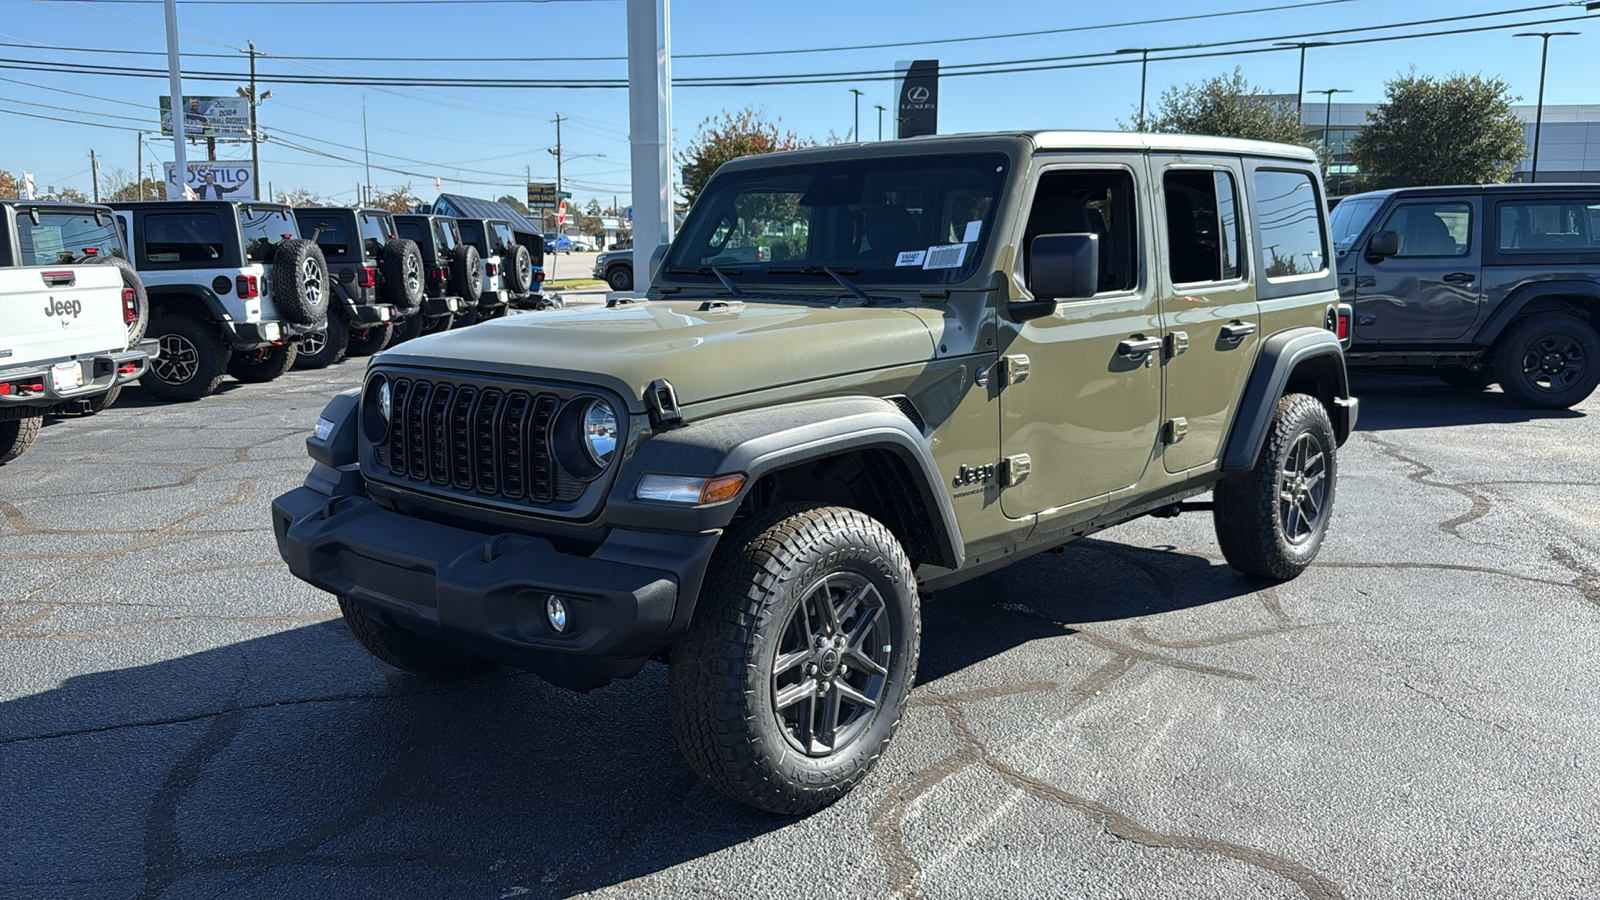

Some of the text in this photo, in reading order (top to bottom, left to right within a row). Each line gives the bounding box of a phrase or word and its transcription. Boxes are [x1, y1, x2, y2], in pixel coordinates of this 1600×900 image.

[218, 109, 237, 117] 2024
[208, 116, 224, 124] SMALL
[221, 125, 231, 133] THE
[44, 296, 82, 318] Jeep
[953, 462, 995, 487] Jeep
[953, 486, 989, 499] WRANGLER
[790, 751, 867, 785] NEXEN
